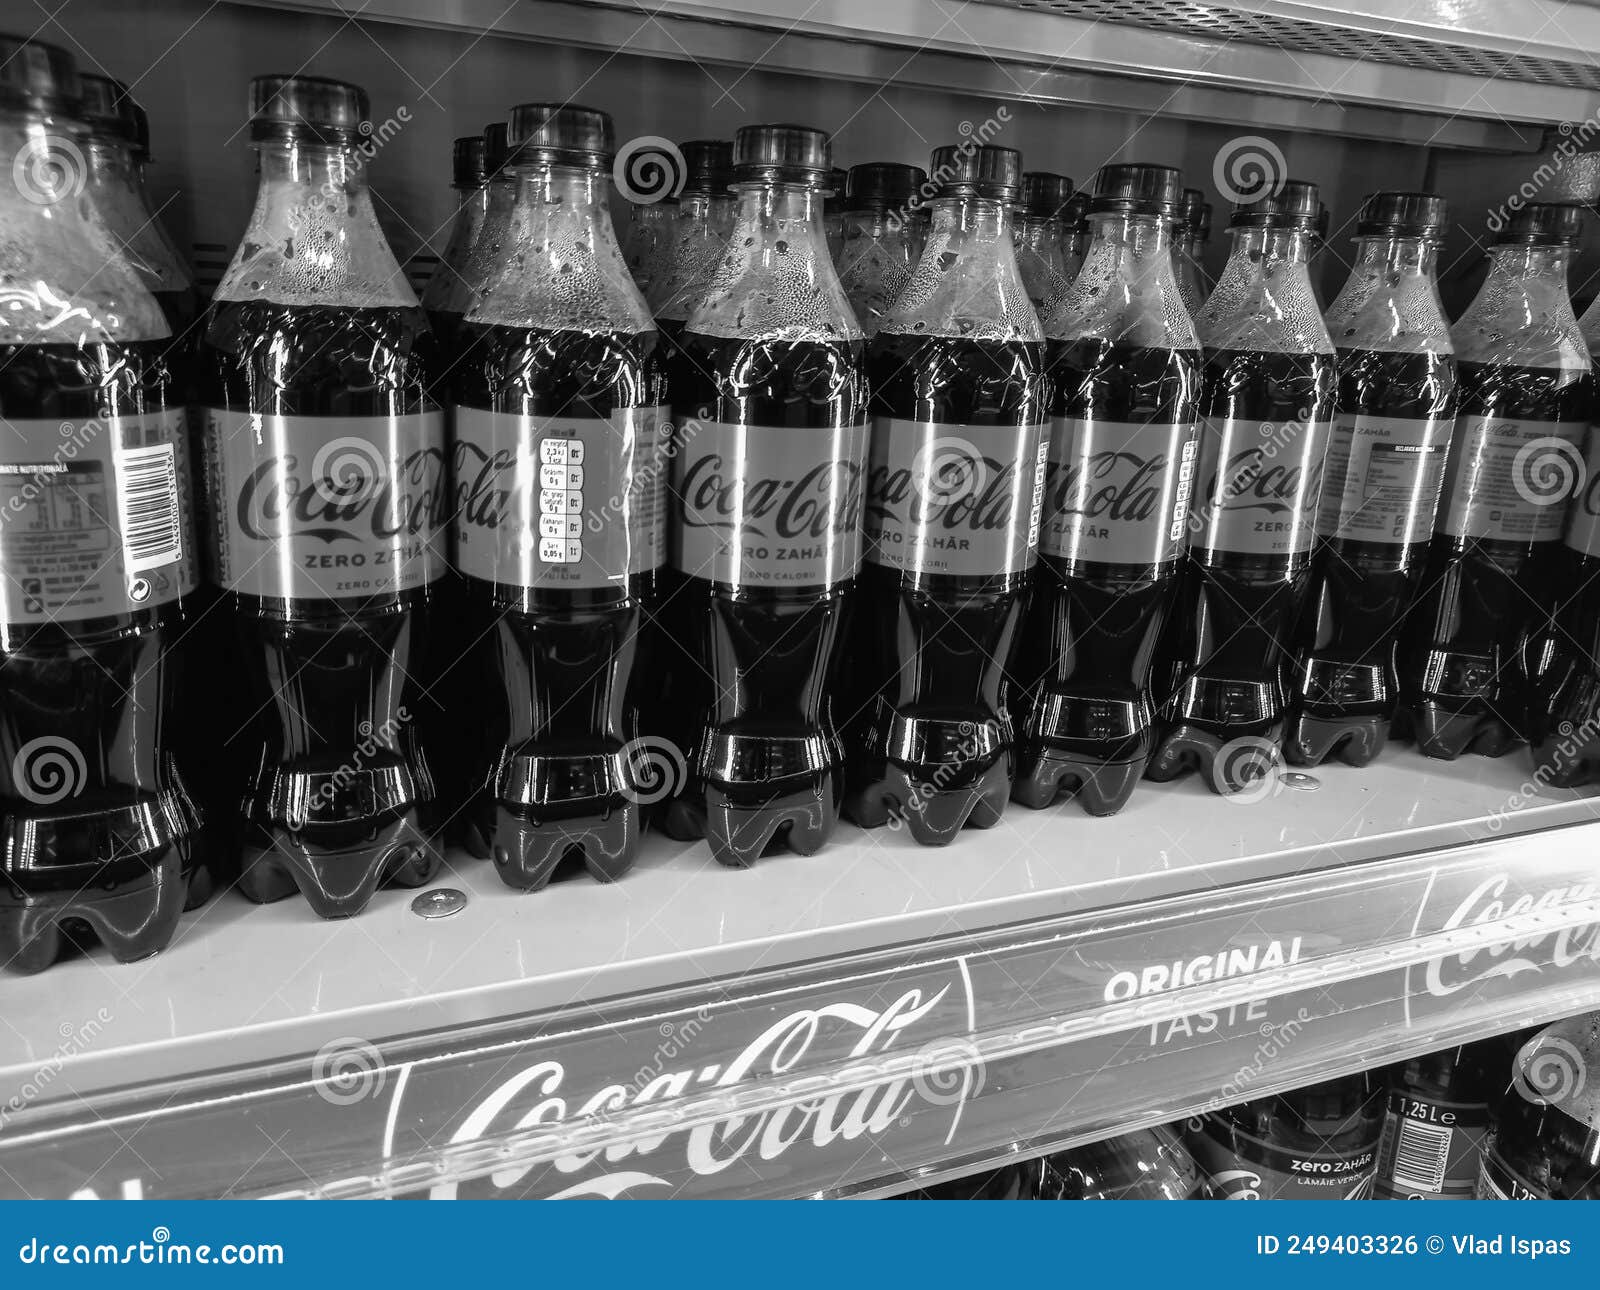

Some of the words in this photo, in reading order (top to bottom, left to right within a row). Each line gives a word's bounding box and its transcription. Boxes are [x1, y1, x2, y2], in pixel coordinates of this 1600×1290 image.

[167, 454, 177, 496] 131836
[719, 543, 769, 560] ZRO
[775, 544, 825, 560] ZAHĂ
[305, 553, 366, 569] ZERO
[336, 580, 371, 590] ZERO
[430, 981, 952, 1200] Coca-Cola
[1400, 1098, 1427, 1120] 1,25
[1429, 1105, 1437, 1122] L
[1291, 1159, 1332, 1173] zero
